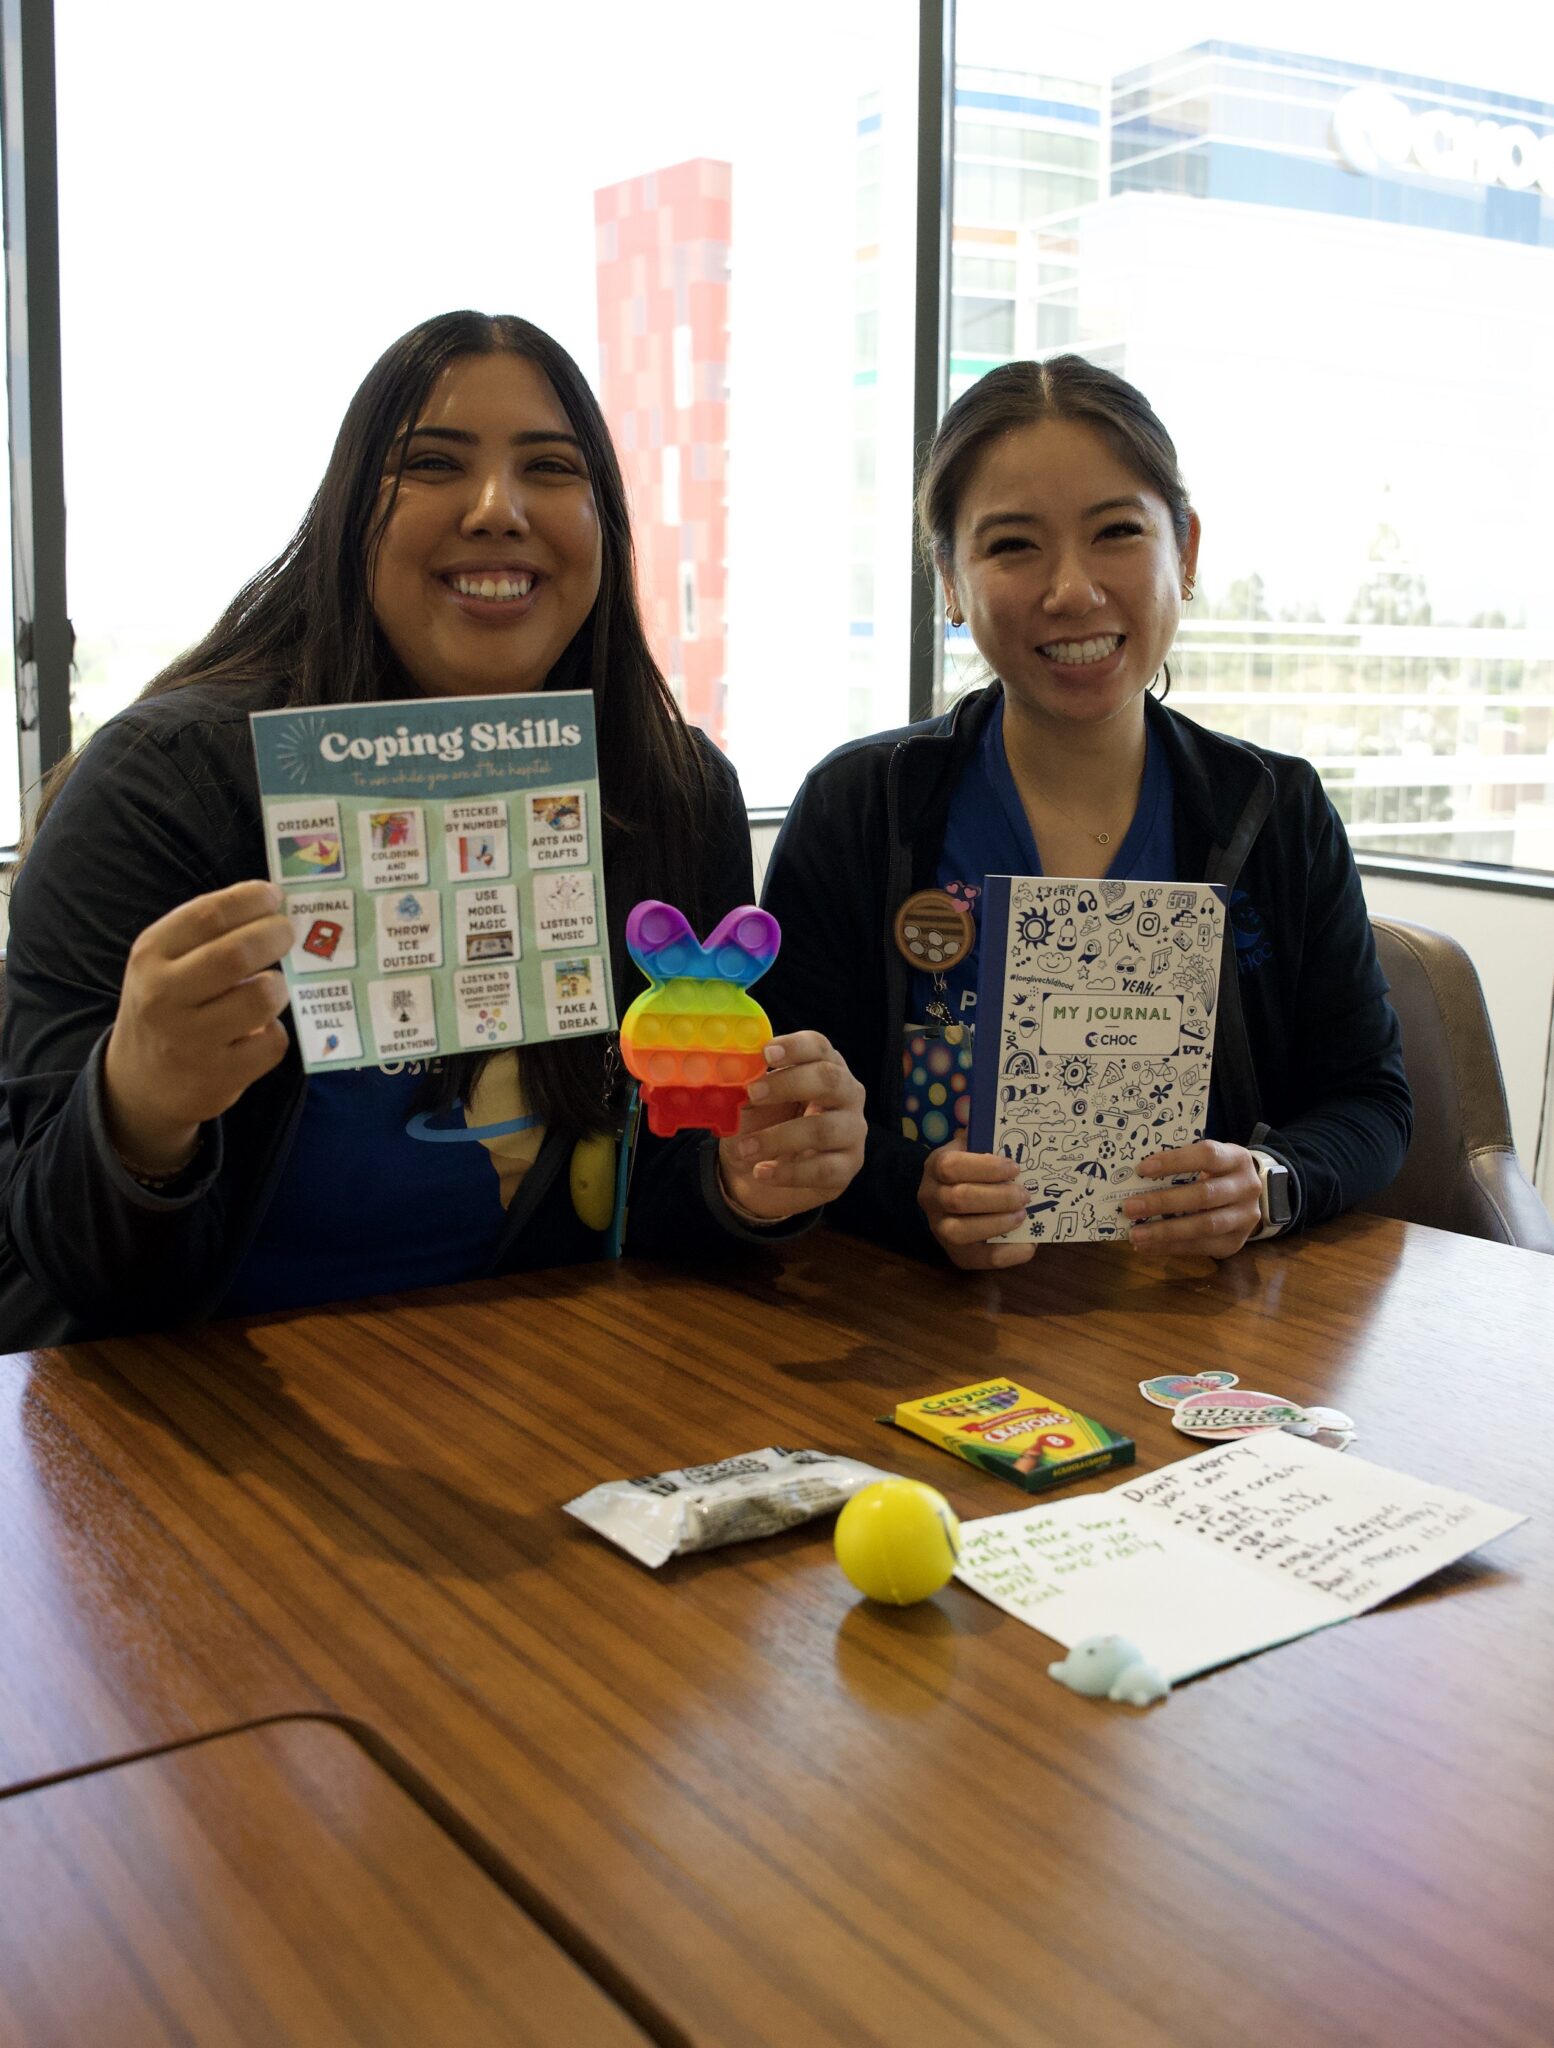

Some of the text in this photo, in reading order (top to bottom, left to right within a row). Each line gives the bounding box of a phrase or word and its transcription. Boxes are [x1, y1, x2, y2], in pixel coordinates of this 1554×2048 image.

[319, 718, 582, 766] Coping Skills
[452, 806, 498, 818] STICKER
[277, 817, 335, 832] ORIGAMI
[445, 819, 507, 833] BY NUMBER
[532, 833, 583, 847] ARTS AND
[372, 849, 419, 861] COLORING
[538, 848, 578, 861] CRAFTS
[387, 859, 406, 870] AND
[375, 873, 419, 884] DRAWING
[474, 889, 499, 901] USE
[292, 900, 349, 915] JOURNAL
[468, 905, 507, 917] MODEL
[469, 918, 507, 931] MAGIC
[541, 916, 593, 930] LISTEN TO
[387, 924, 430, 937] THROW
[552, 930, 584, 941] MUSIC
[398, 940, 419, 951] ICE
[383, 953, 436, 968] OUTSIDE
[1238, 942, 1272, 974] HOC
[462, 971, 509, 984] LISTEN TO
[1010, 973, 1075, 991] #longlivechildhood
[299, 985, 349, 999] SQUEEZE
[460, 983, 511, 996] YOUR BODY
[1122, 977, 1162, 996] YEAH!
[301, 1000, 353, 1015] A STRESS
[556, 1001, 598, 1015] TAKE A
[1053, 1006, 1171, 1022] MY JOURNAL
[315, 1018, 344, 1030] BALL
[559, 1016, 598, 1030] BREAK
[393, 1027, 419, 1038] DEEP
[1100, 1034, 1137, 1045] CHOC
[380, 1039, 436, 1054] BREATHING
[922, 1384, 1003, 1411] Crayola
[983, 1413, 1072, 1444] CRAYONS
[1046, 1435, 1065, 1447] 8
